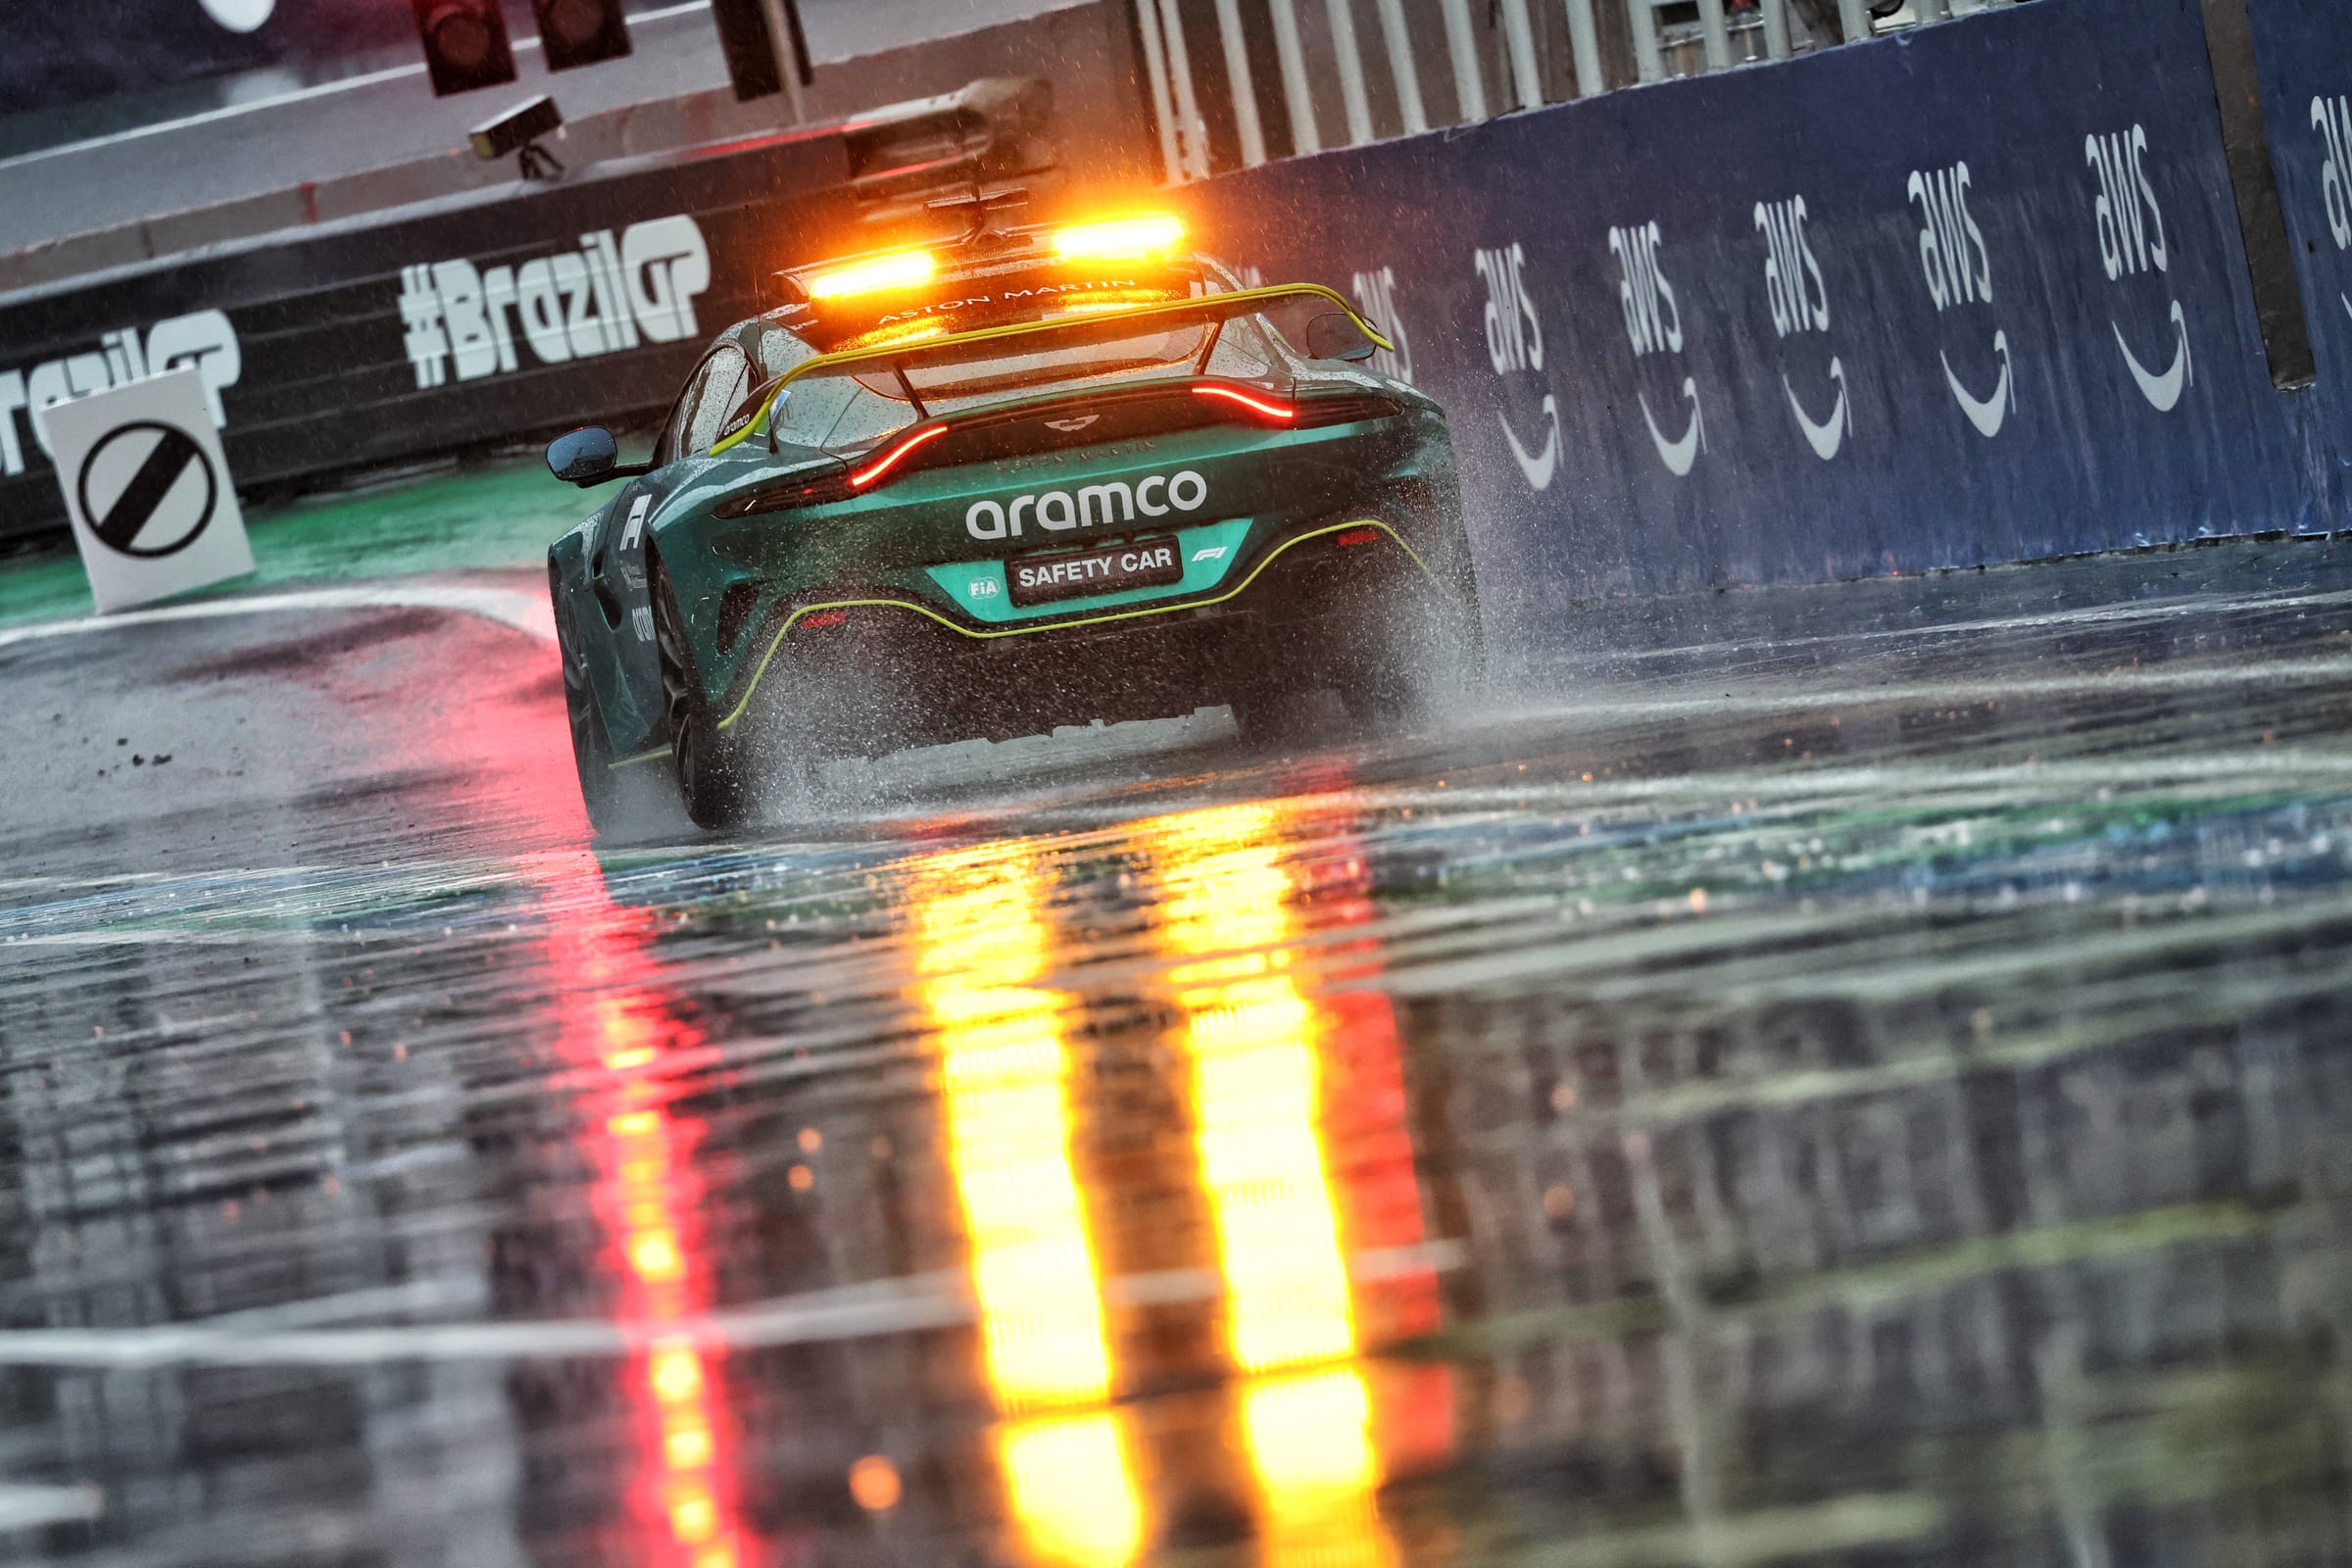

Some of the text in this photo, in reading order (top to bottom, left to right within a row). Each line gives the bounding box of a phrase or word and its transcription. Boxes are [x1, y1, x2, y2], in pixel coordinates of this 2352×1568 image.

[1753, 194, 1830, 338] aws
[1907, 160, 1993, 313] aws
[2084, 122, 2168, 282] aws
[397, 213, 710, 390] #BrazilGP
[878, 278, 1137, 325] ASTON MARTIN
[1475, 241, 1544, 376] aws
[1608, 220, 1684, 357] aws
[965, 470, 1207, 539] aramco
[1018, 547, 1173, 588] SAFETY CAR
